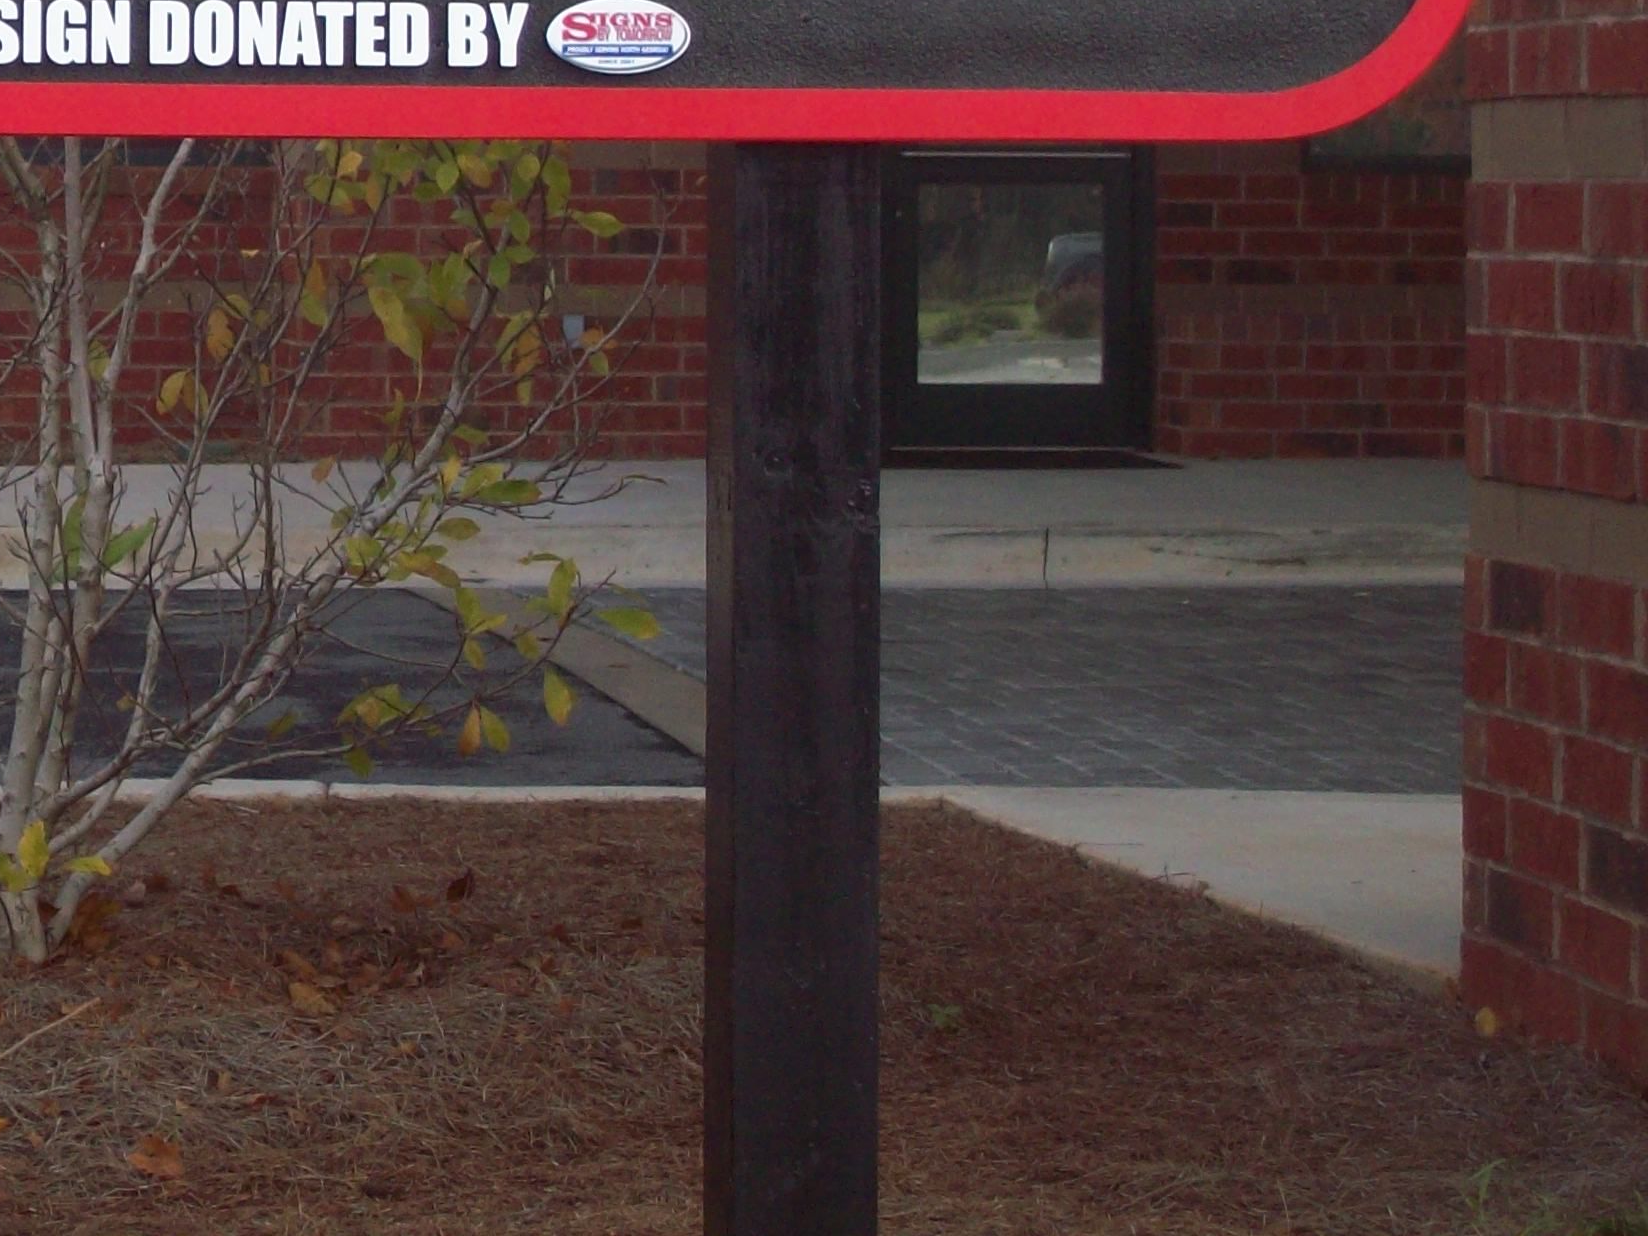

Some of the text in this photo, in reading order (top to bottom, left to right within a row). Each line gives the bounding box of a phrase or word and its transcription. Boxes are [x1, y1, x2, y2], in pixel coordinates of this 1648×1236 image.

[149, 0, 430, 68] DONATED
[447, 2, 529, 68] BY
[562, 12, 673, 42] SIGNS
